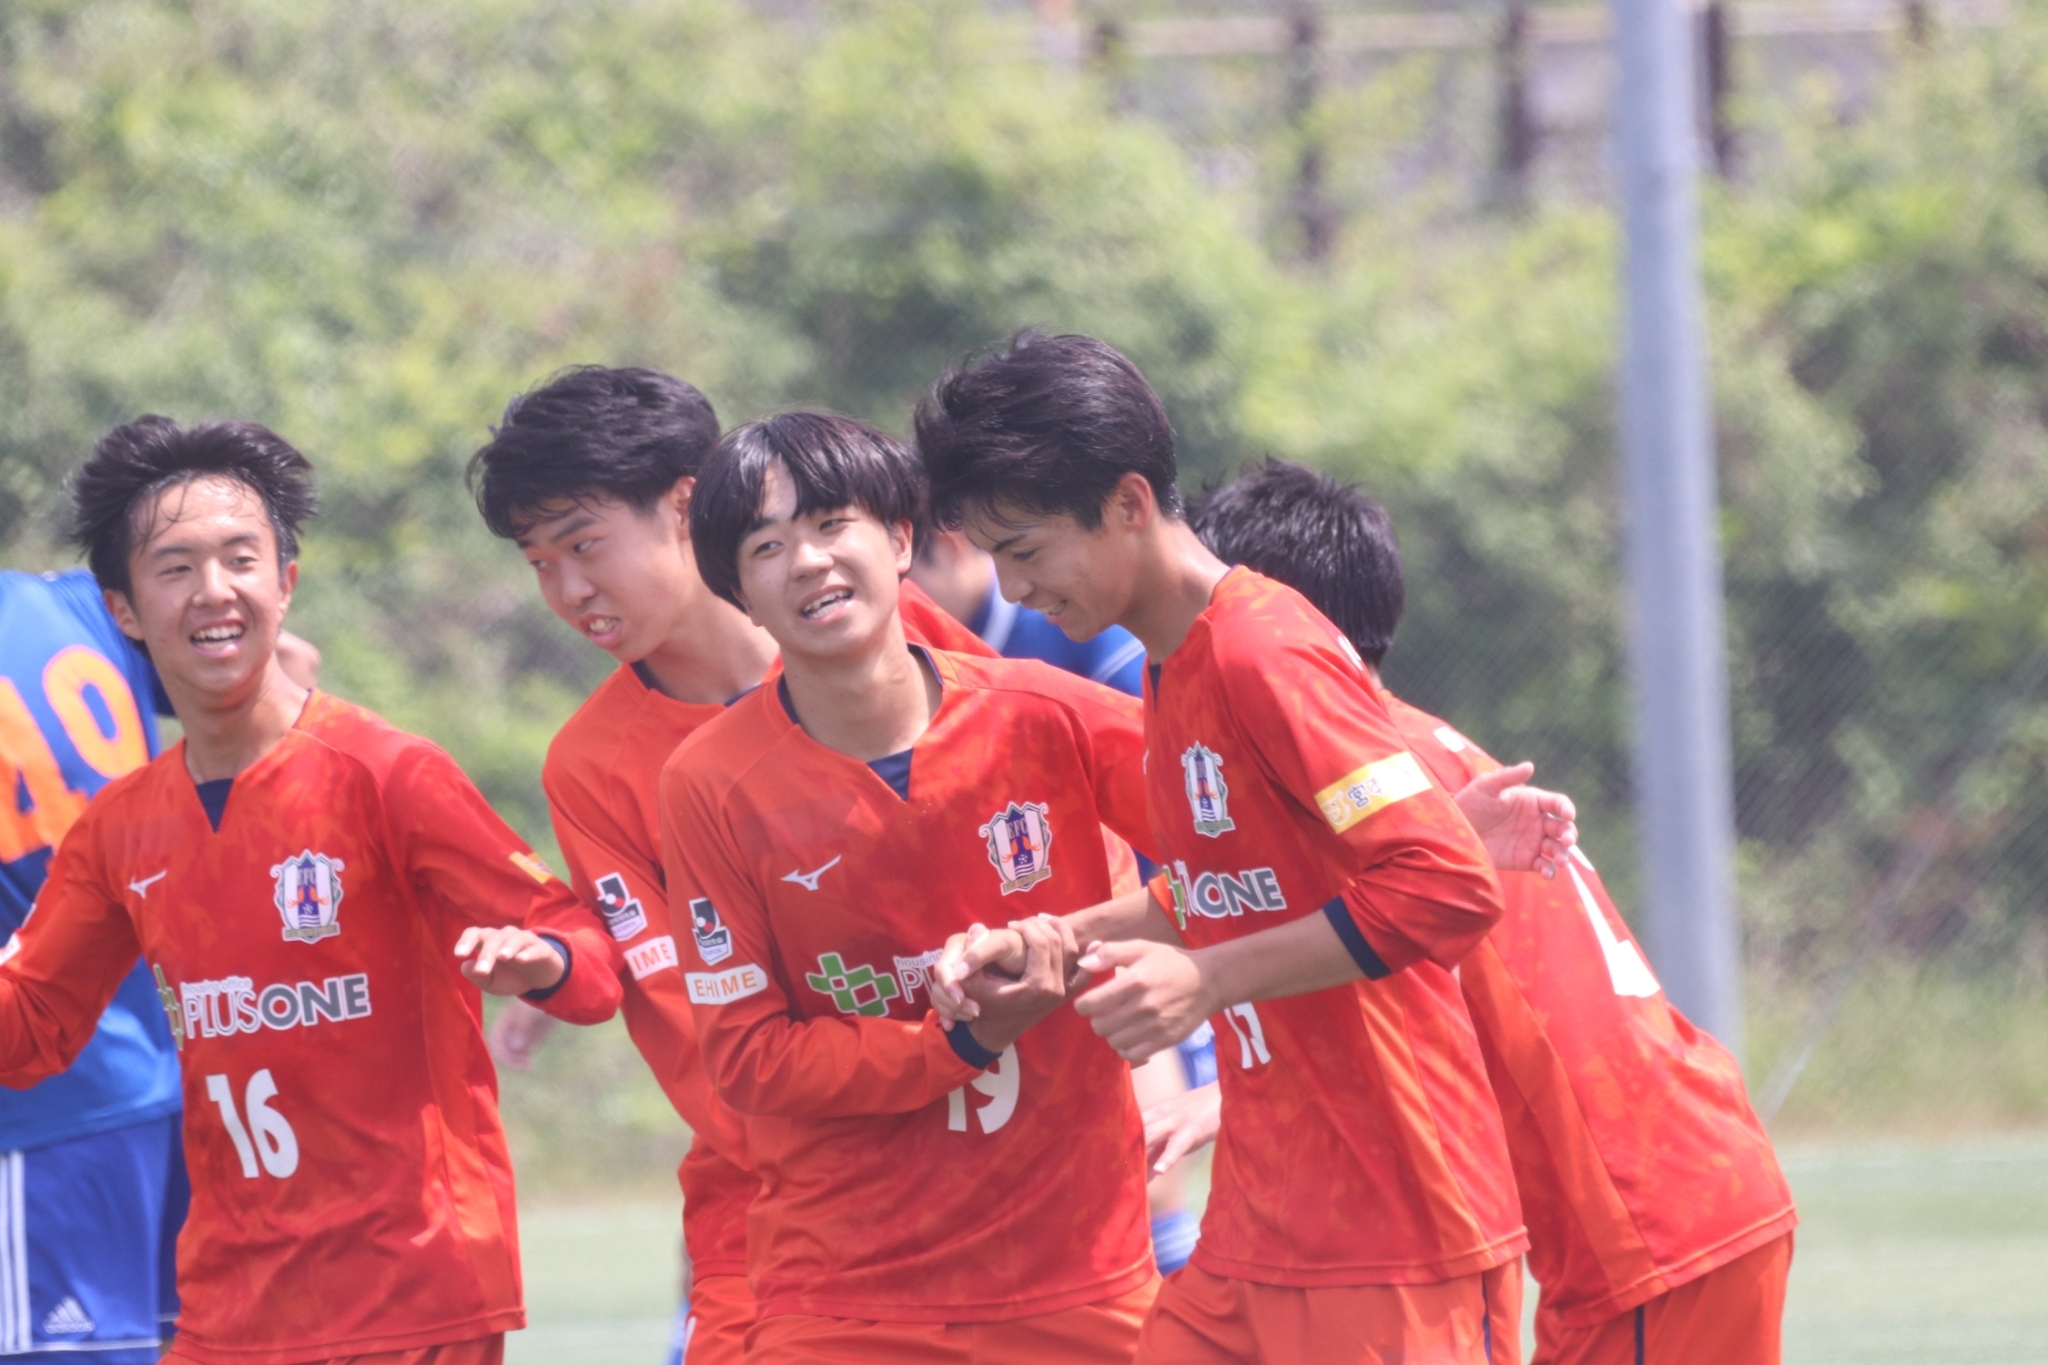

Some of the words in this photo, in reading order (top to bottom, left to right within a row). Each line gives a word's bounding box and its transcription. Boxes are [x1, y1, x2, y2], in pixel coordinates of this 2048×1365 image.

[183, 973, 371, 1039] PLUSONE
[694, 970, 758, 999] EHIME
[205, 1068, 299, 1178] 16
